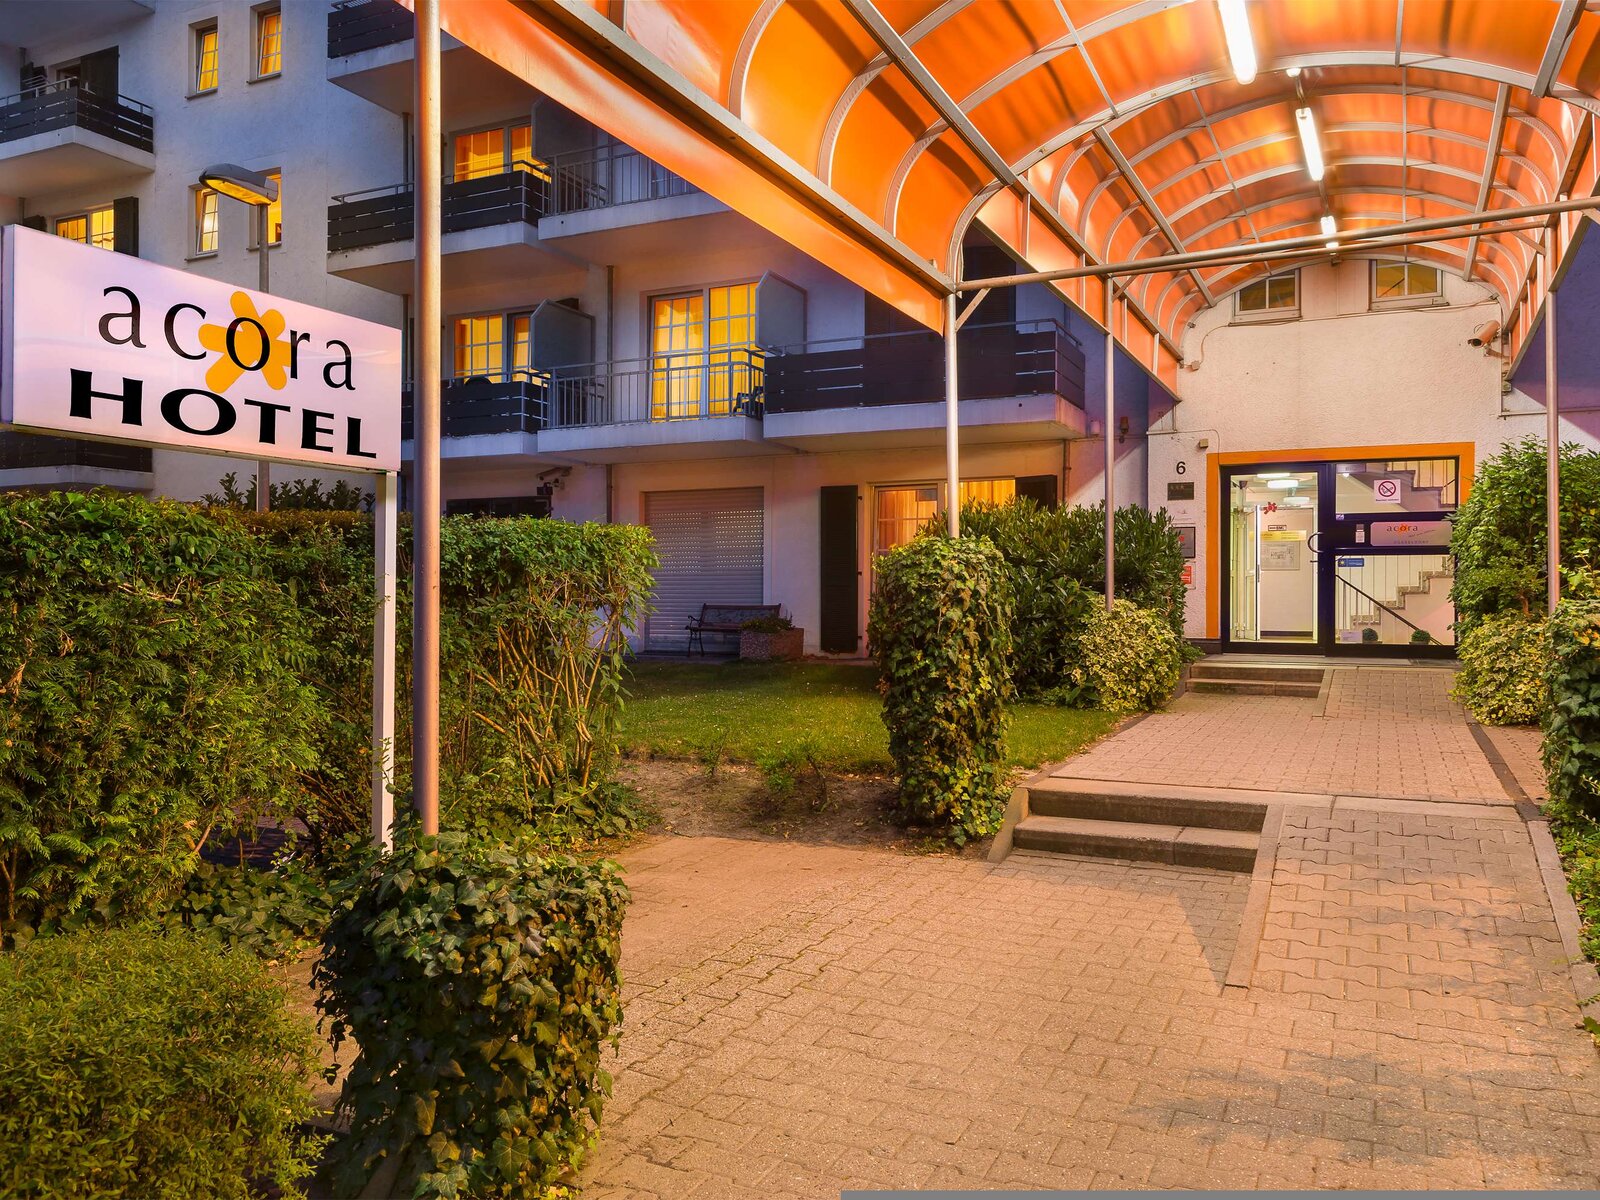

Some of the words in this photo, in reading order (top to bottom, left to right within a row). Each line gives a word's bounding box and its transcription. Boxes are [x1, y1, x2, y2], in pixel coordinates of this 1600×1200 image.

[98, 286, 356, 391] acora
[70, 368, 377, 459] HOTEL
[1176, 461, 1186, 475] 6
[1386, 524, 1419, 532] acora
